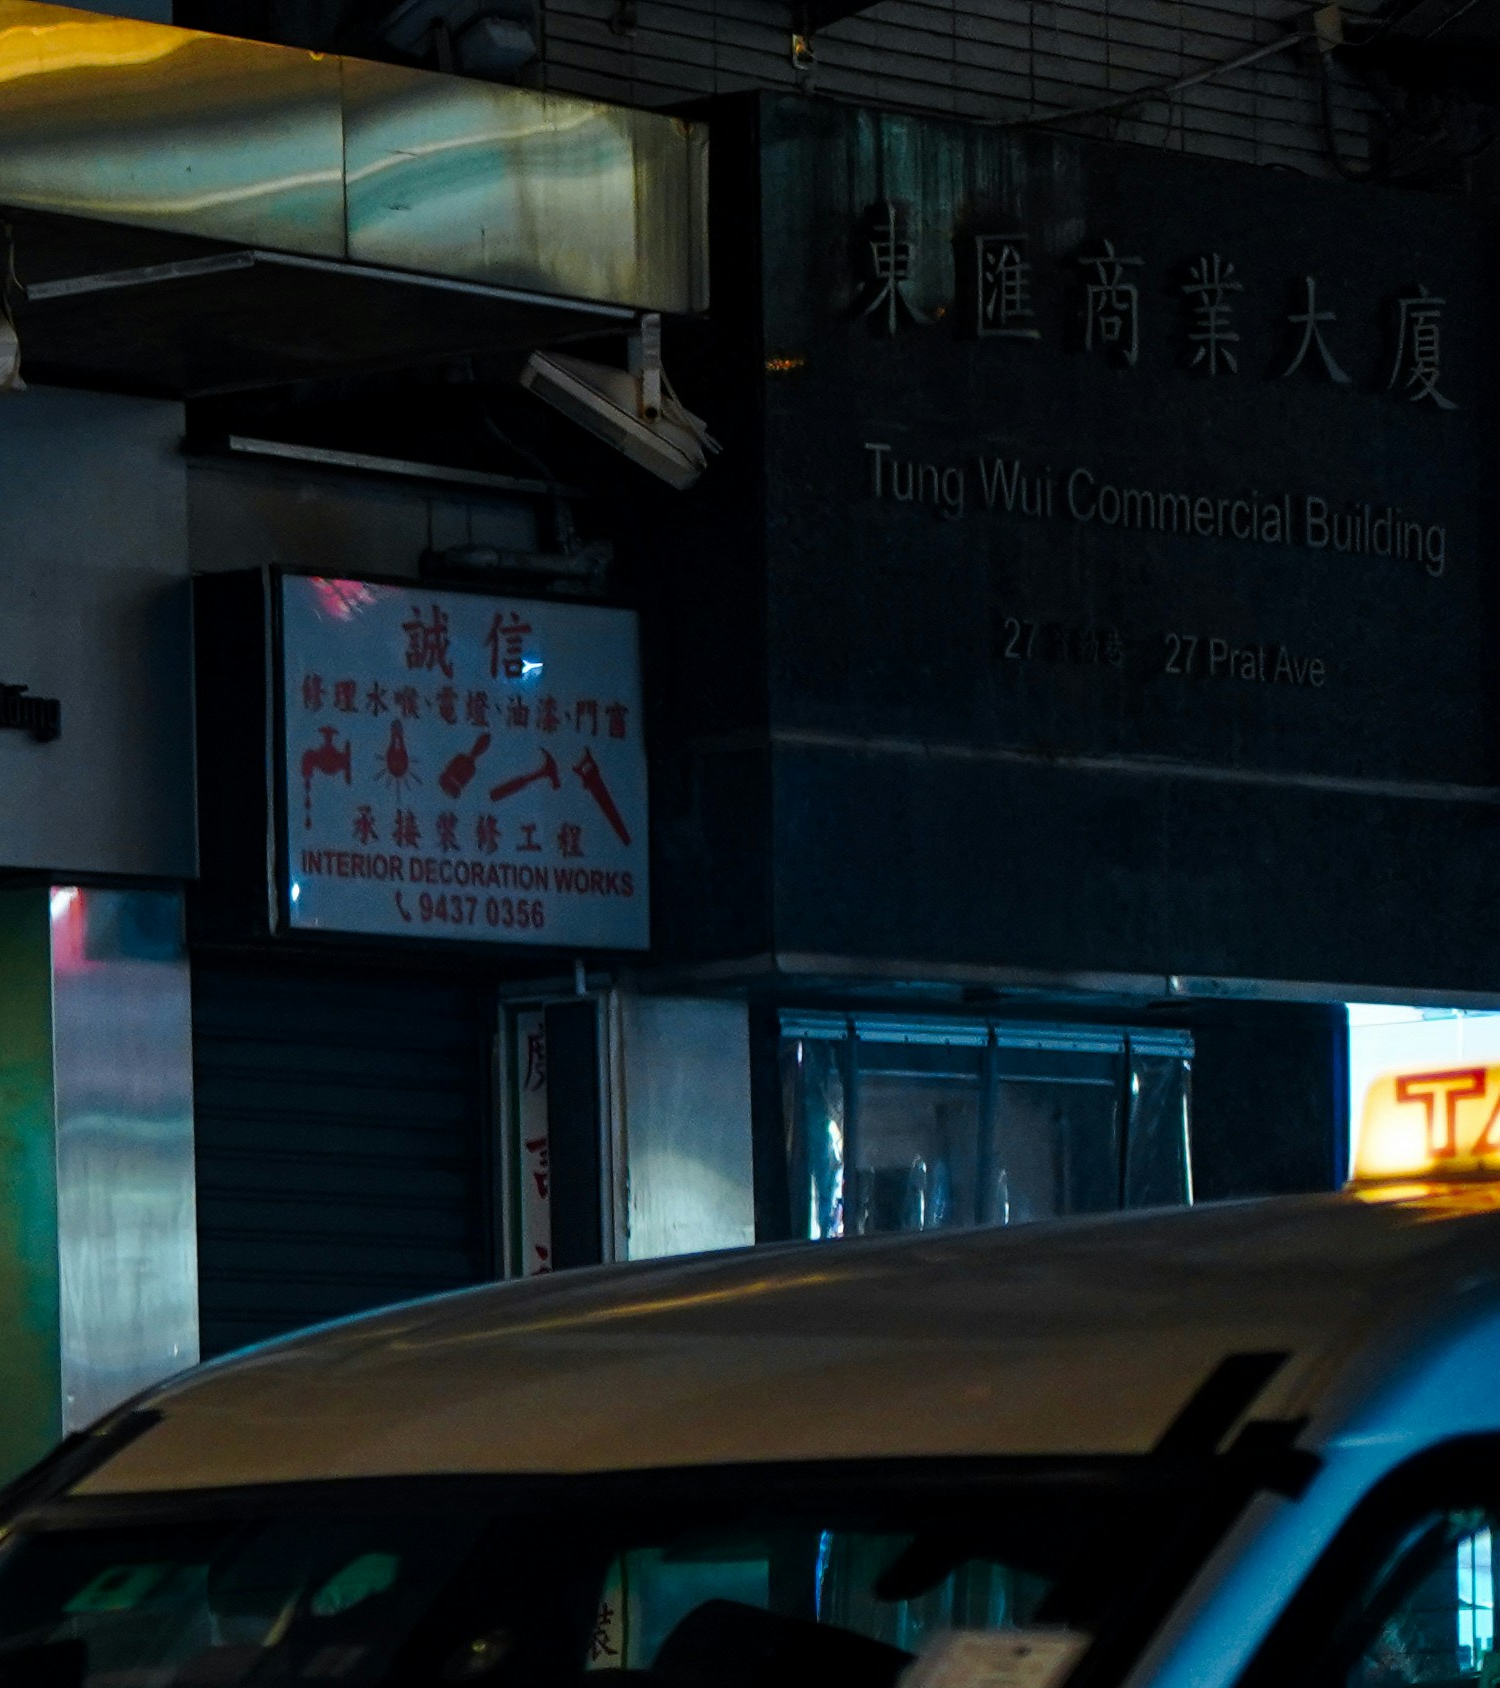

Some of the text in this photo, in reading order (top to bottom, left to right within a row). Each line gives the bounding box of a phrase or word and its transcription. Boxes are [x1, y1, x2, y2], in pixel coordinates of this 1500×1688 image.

[856, 198, 1466, 412] 東匯商業大廈
[864, 442, 1446, 577] Tung Wui Commercial Building
[402, 604, 534, 680] 誠信
[1003, 616, 1037, 661] 27
[1164, 632, 1326, 688] 27 Prat Ave
[352, 804, 585, 859] 承接裝修工程
[301, 848, 634, 898] INTERIOR DECORATION WORKS
[418, 892, 545, 929] 9437 0356
